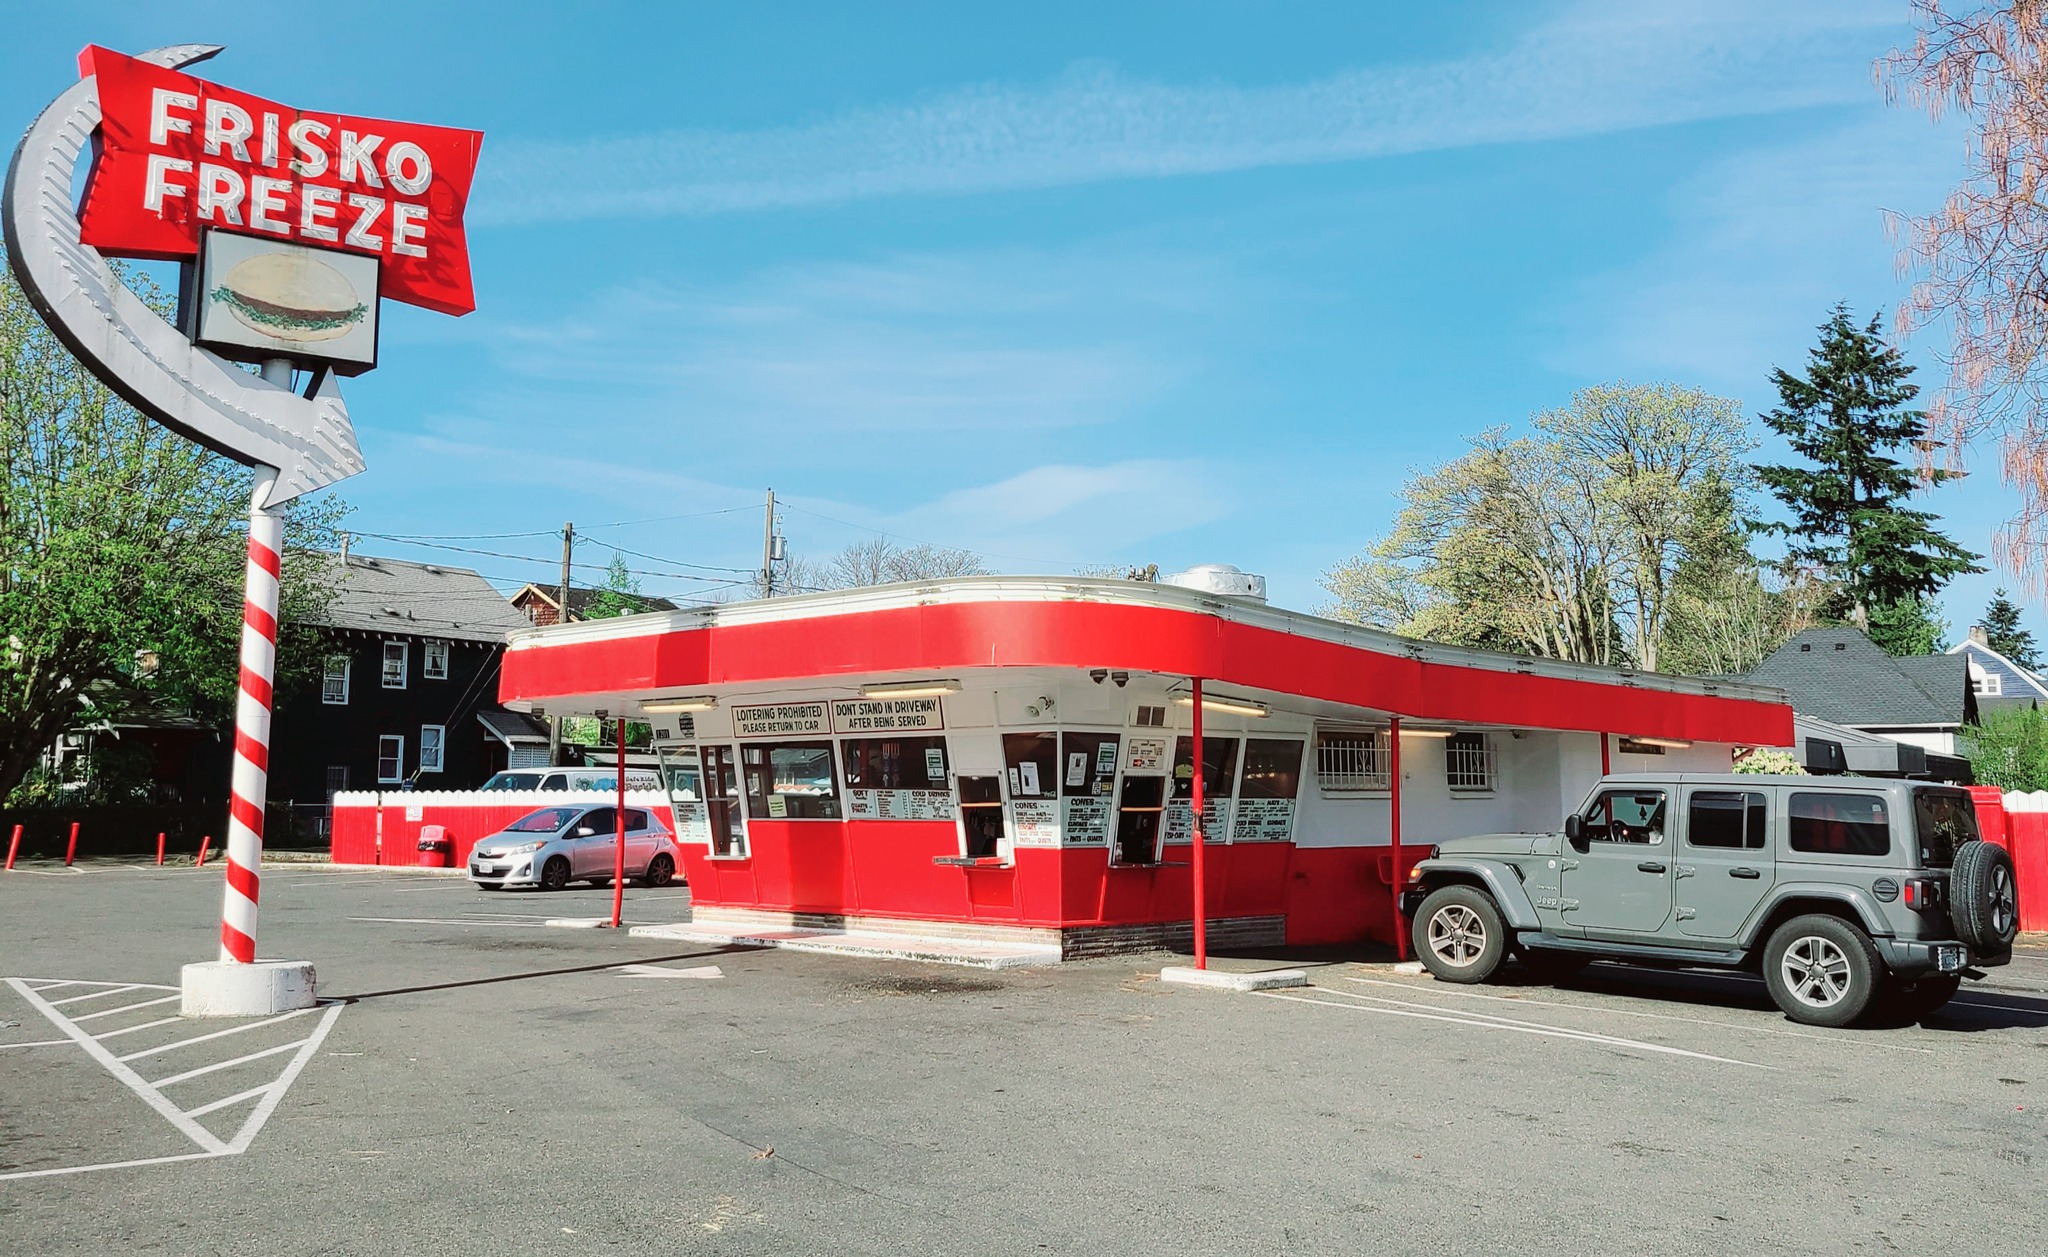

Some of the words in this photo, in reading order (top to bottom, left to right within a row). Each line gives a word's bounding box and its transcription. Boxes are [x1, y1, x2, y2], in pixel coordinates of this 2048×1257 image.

[149, 88, 432, 195] FRISKO
[144, 154, 429, 258] FREEZE
[736, 708, 775, 721] LOITERING
[777, 705, 822, 719] PROHIBITED
[836, 703, 856, 716] DONT
[859, 702, 883, 715] STAND
[884, 701, 893, 714] IN
[895, 699, 937, 713] DRIVEWAY
[743, 722, 767, 733] PLEASE
[768, 721, 793, 732] RETURN
[794, 721, 803, 731] TO
[804, 720, 819, 730] CAR
[849, 717, 872, 729] AFTER
[874, 716, 895, 728] BEING
[897, 715, 926, 727] SERVED
[1071, 798, 1095, 806] CONES
[1536, 895, 1557, 906] Jeep
